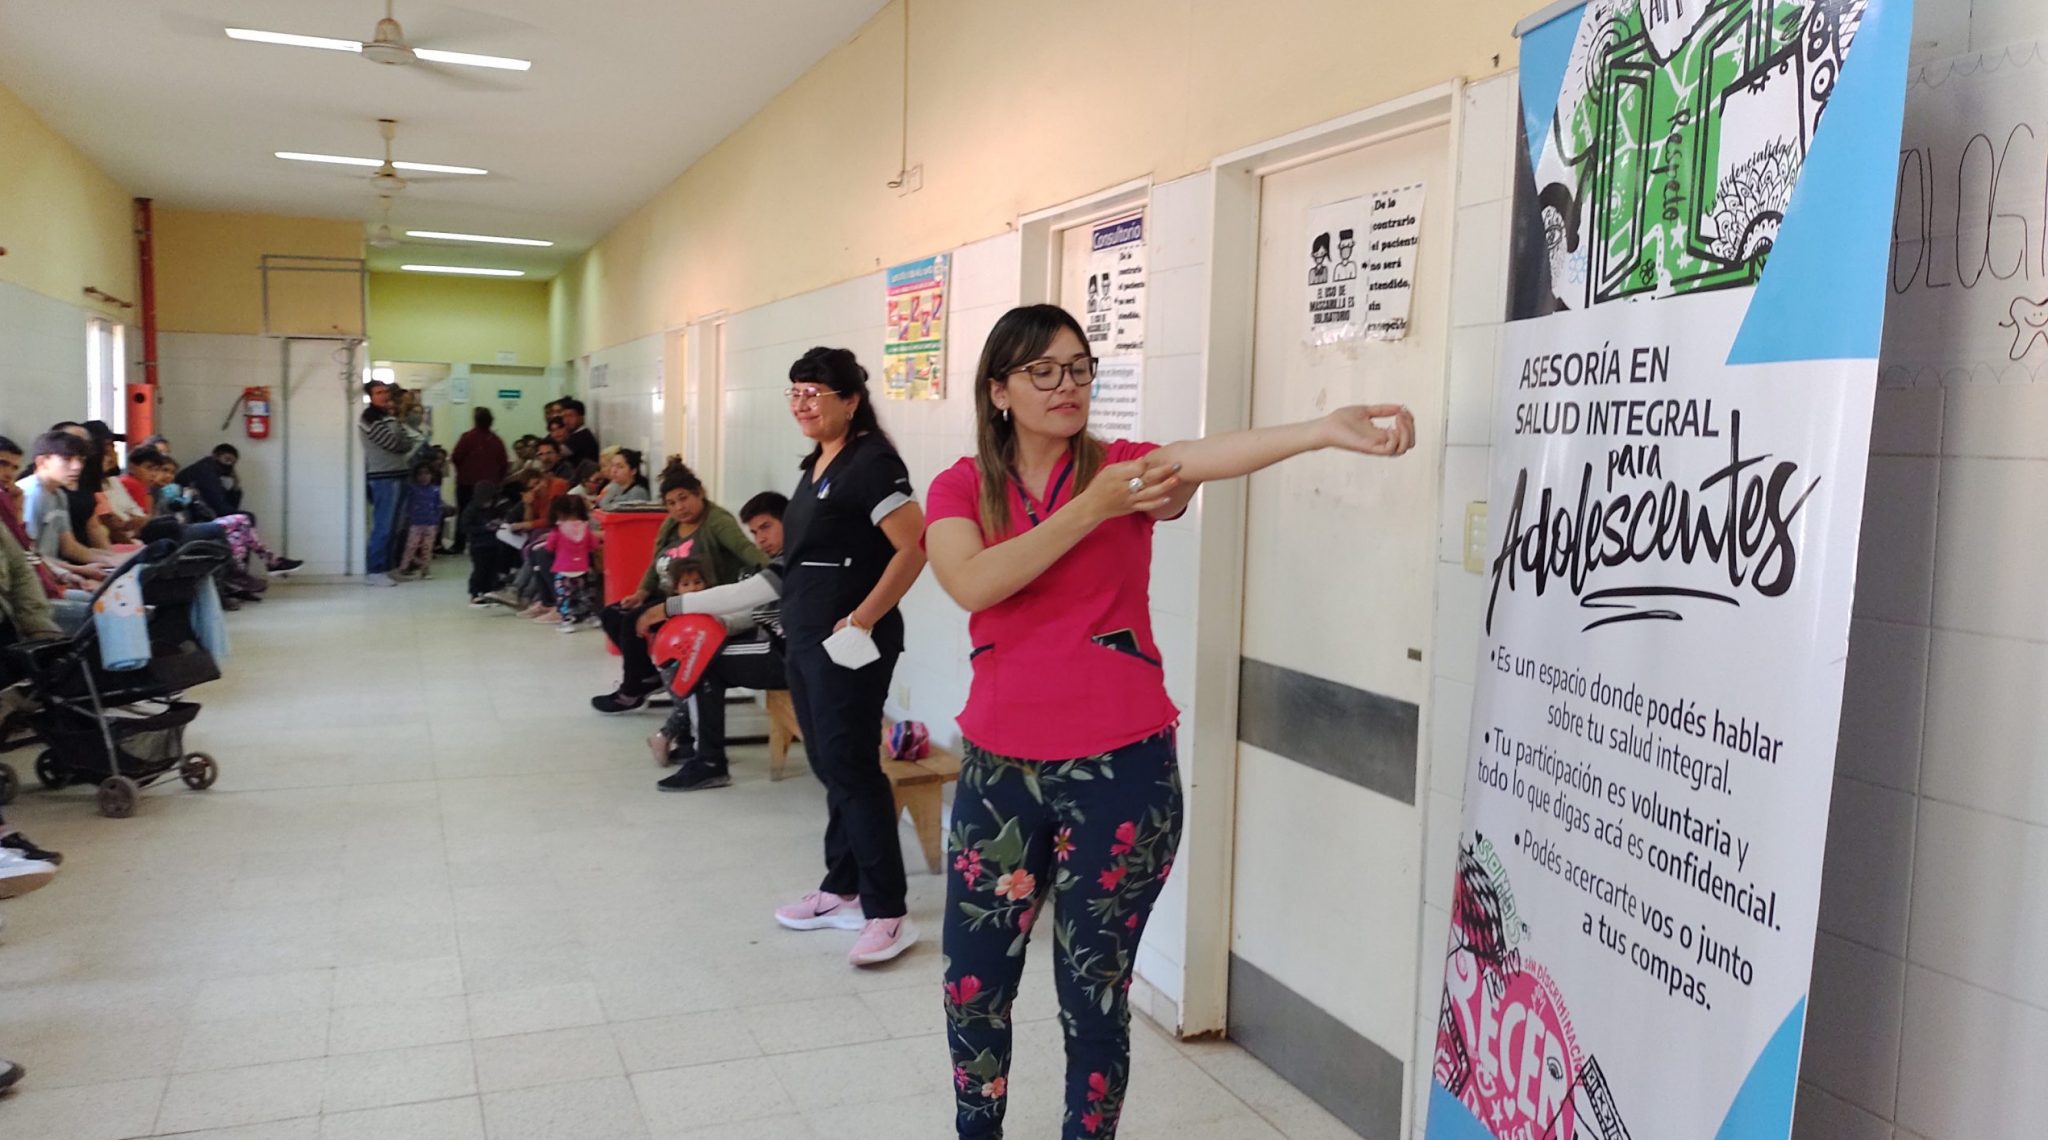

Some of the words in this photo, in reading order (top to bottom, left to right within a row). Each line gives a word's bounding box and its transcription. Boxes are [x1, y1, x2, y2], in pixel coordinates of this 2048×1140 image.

[1374, 199, 1386, 211] De
[1650, 108, 1691, 221] Respeto
[1370, 261, 1381, 271] no
[1372, 214, 1416, 231] contrario
[1519, 341, 1622, 390] ASESORÍA
[1629, 346, 1670, 384] EN
[1515, 401, 1580, 436] SALUD
[1586, 399, 1720, 438] INTEGRAL
[1607, 444, 1662, 493] para
[1486, 410, 1821, 635] Adolescentes
[1497, 646, 1511, 673] Es
[1515, 656, 1535, 681] un
[1539, 663, 1587, 698] espacio
[1590, 673, 1644, 716] donde
[1647, 698, 1707, 738] podés
[1713, 708, 1784, 765] hablar
[1547, 701, 1583, 737] sobre
[1587, 713, 1604, 745] tu
[1609, 725, 1653, 763] salud
[1656, 737, 1732, 796] integral.
[1478, 757, 1508, 791] todo
[1512, 769, 1524, 799] lo
[1527, 785, 1551, 814] que
[1553, 791, 1590, 834] digas
[1594, 817, 1623, 850] acá
[1627, 833, 1644, 860] es
[1648, 842, 1781, 932] confidencial.
[1494, 727, 1511, 756] Tu
[1515, 741, 1603, 798] participación
[1607, 781, 1626, 808] es
[1631, 790, 1731, 858] voluntaria
[1738, 838, 1749, 872] y
[1523, 829, 1562, 875] Podés
[1564, 860, 1637, 918] acercarte
[1640, 901, 1674, 940] vos
[1680, 924, 1693, 949] o
[1696, 925, 1753, 986] junto
[1582, 912, 1593, 936] a
[1598, 914, 1627, 956] tus
[1631, 942, 1711, 1011] compas.
